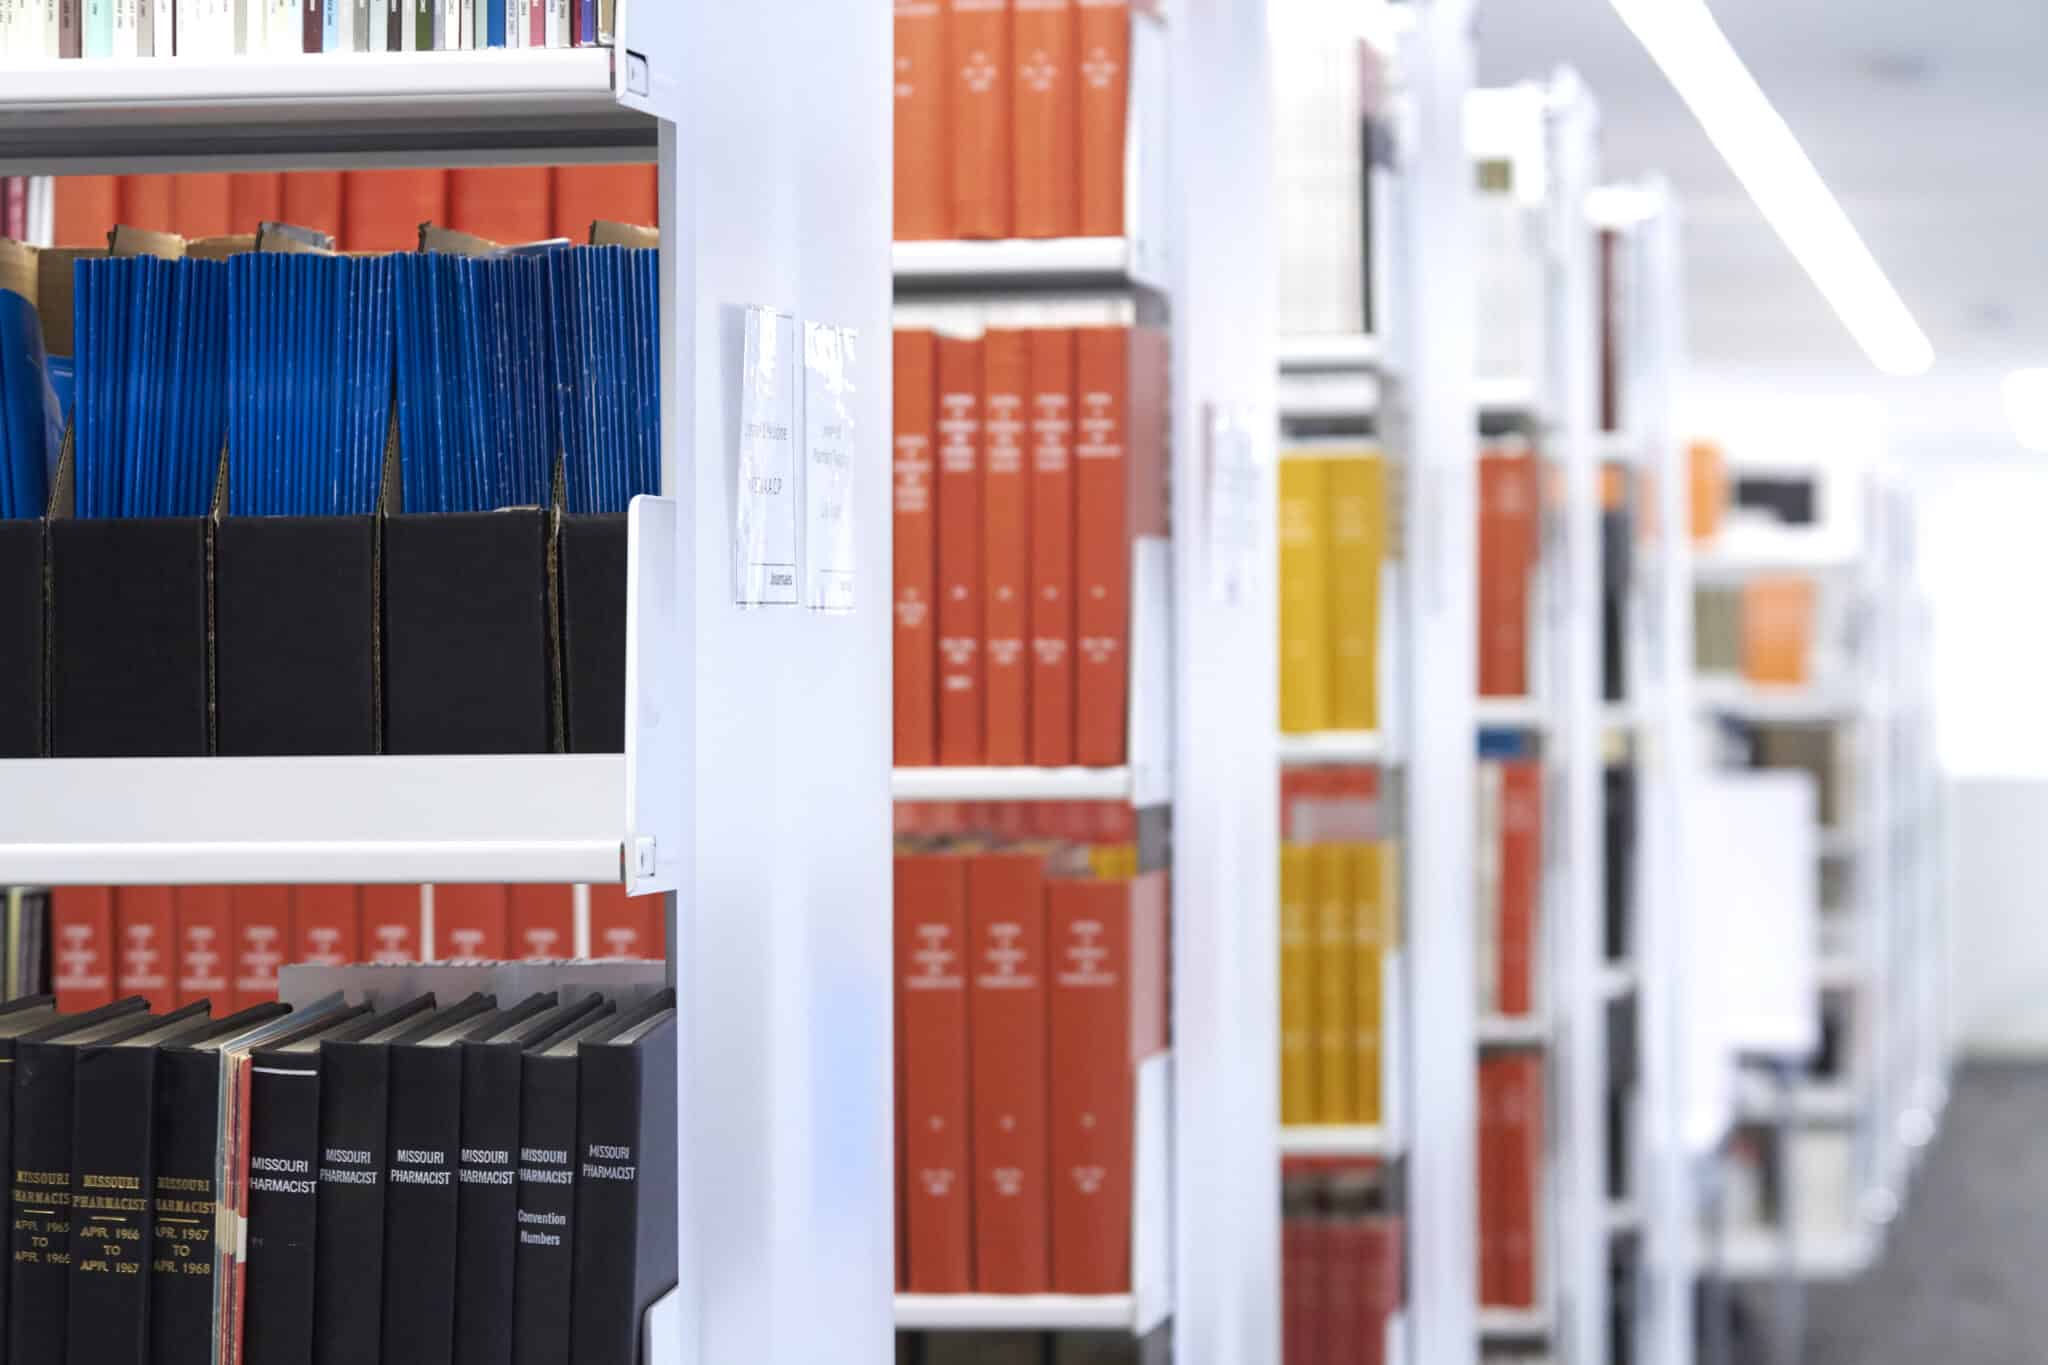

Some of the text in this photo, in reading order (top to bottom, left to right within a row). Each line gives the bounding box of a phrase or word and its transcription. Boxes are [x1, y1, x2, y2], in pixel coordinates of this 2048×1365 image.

[326, 1149, 371, 1164] MISSOURI
[397, 1149, 444, 1164] MISSOURI
[461, 1149, 509, 1164] MISSOURI
[521, 1148, 568, 1164] MISSOURI
[589, 1144, 630, 1160] MISSOURI
[252, 1157, 309, 1173] MISSOURI
[583, 1163, 636, 1180] PHARMACIST
[16, 1170, 71, 1185] MISSOURI
[83, 1174, 140, 1190] MISSOURI
[157, 1176, 210, 1192] MISSOURI
[320, 1168, 378, 1185] PHARMACIST
[391, 1169, 451, 1185] PHARMACIST
[460, 1169, 515, 1185] HARMACIST
[519, 1168, 574, 1185] HARMACIST
[250, 1177, 317, 1194] HARMACIST
[72, 1195, 146, 1211] PHARMACIST
[156, 1198, 217, 1215] HARMACIST
[518, 1209, 567, 1225] Convention
[80, 1226, 141, 1241] APR. 1966
[182, 1228, 209, 1241] 1967
[521, 1229, 561, 1246] Numbers
[32, 1236, 49, 1248] TO
[104, 1244, 121, 1257] TO
[173, 1244, 191, 1257] TO
[80, 1260, 109, 1273] APR.
[183, 1261, 210, 1275] 1968
